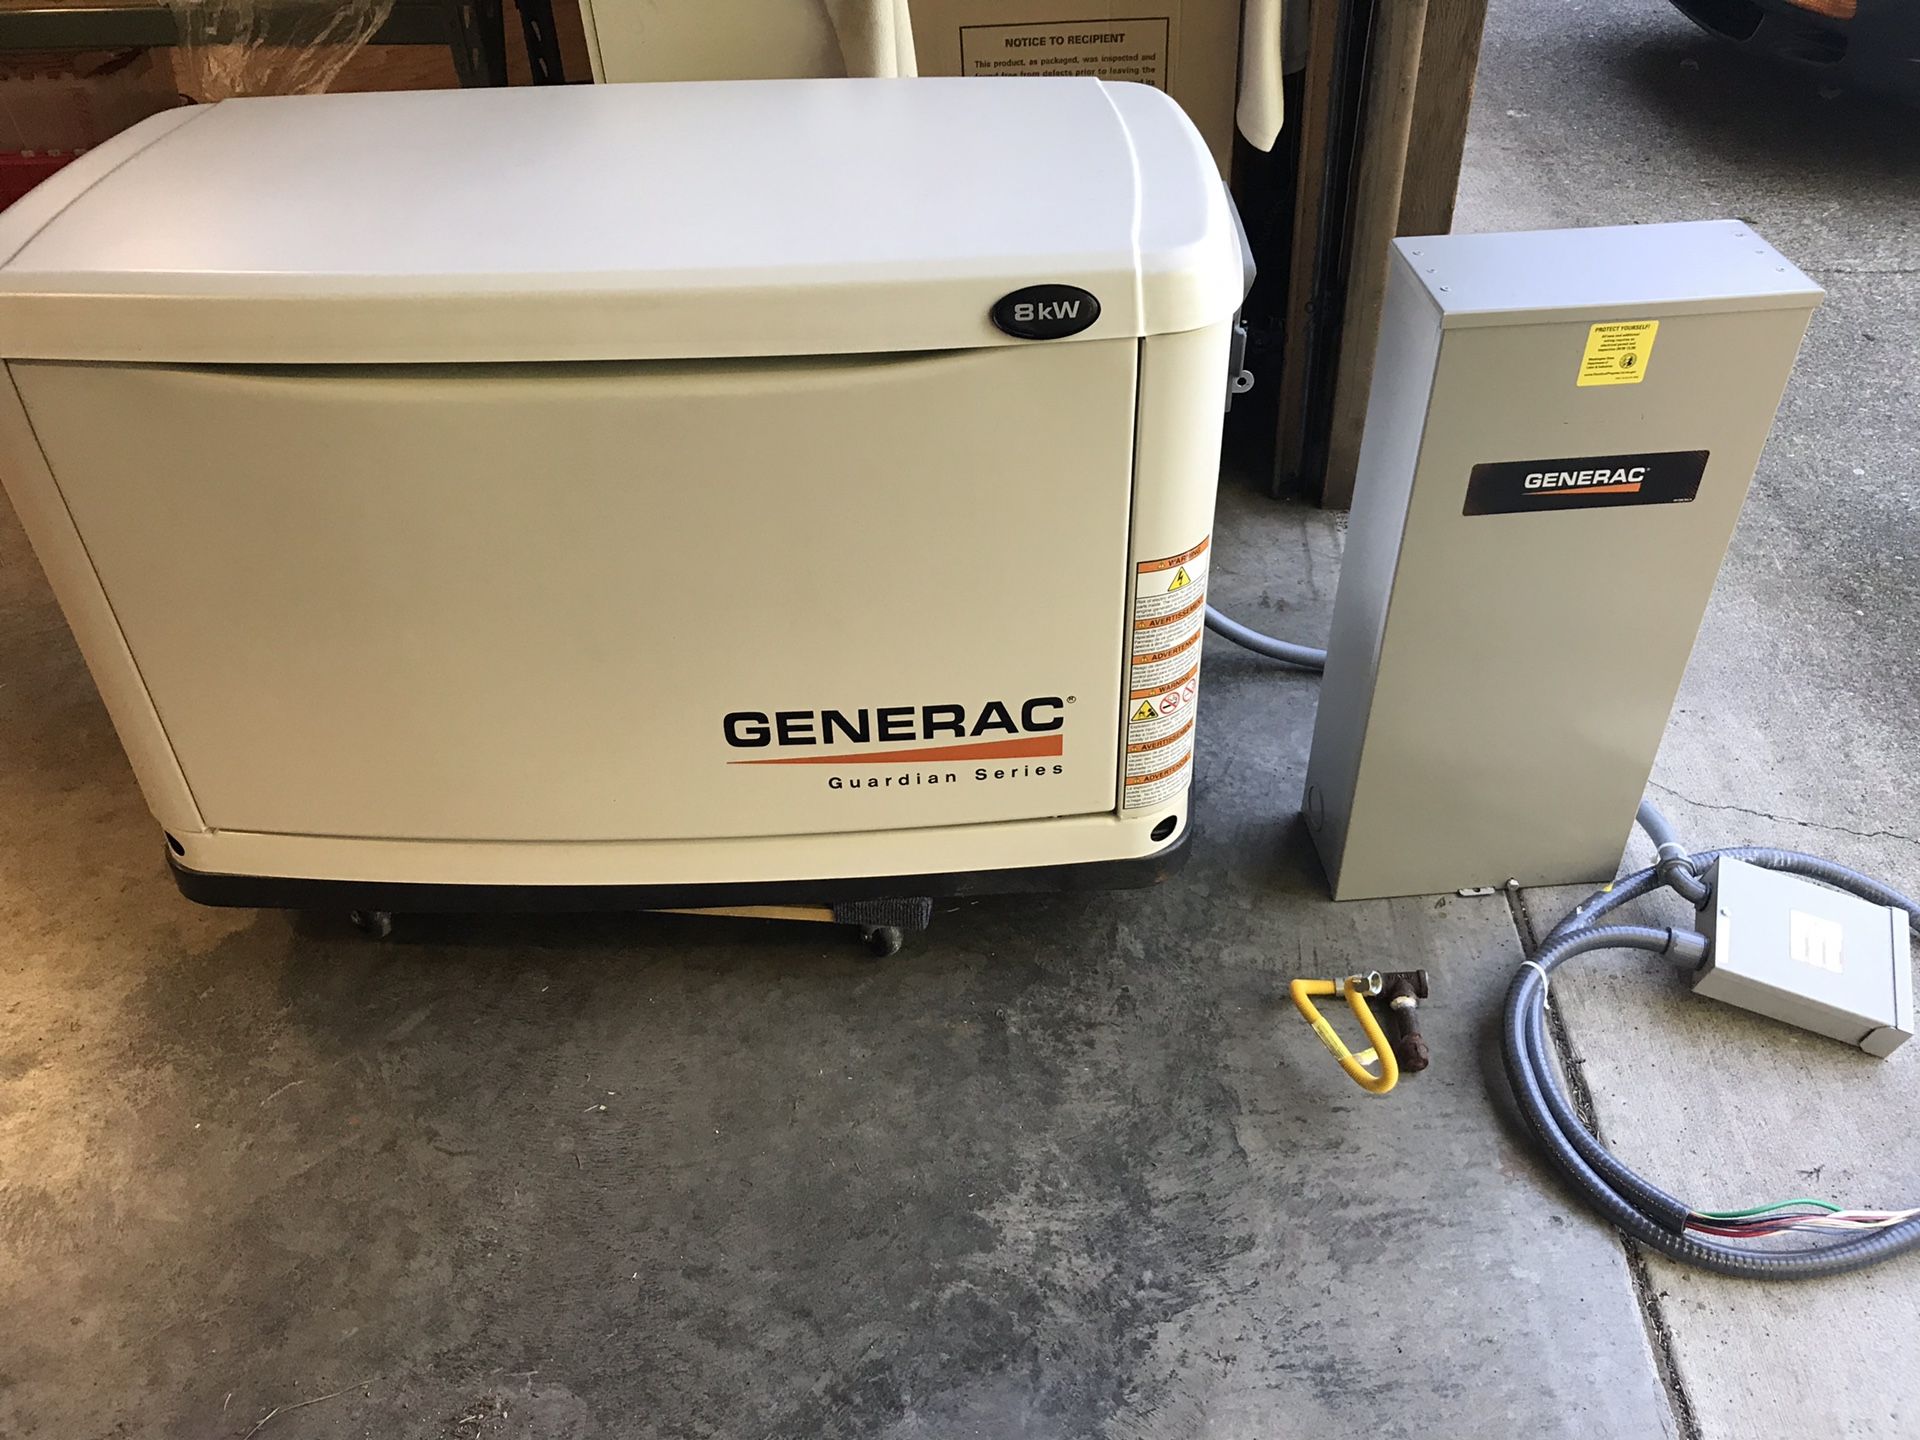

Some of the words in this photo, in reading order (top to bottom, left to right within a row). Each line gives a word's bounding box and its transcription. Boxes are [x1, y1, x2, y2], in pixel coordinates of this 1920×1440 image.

[1005, 37, 1046, 48] NOTICE
[1050, 36, 1065, 46] TO
[1068, 33, 1125, 45] RECIPIENT
[975, 60, 991, 68] This
[1101, 53, 1139, 63] inspected
[1141, 53, 1156, 61] and
[1042, 69, 1073, 77] defects
[1075, 68, 1095, 77] prior
[1109, 66, 1139, 75] leaving
[1142, 65, 1156, 73] the
[1524, 467, 1646, 489] GENERAC
[1168, 545, 1202, 566] WARING
[723, 696, 1065, 748] GENERAC
[828, 770, 957, 790] Guardian
[974, 763, 1064, 781] Series
